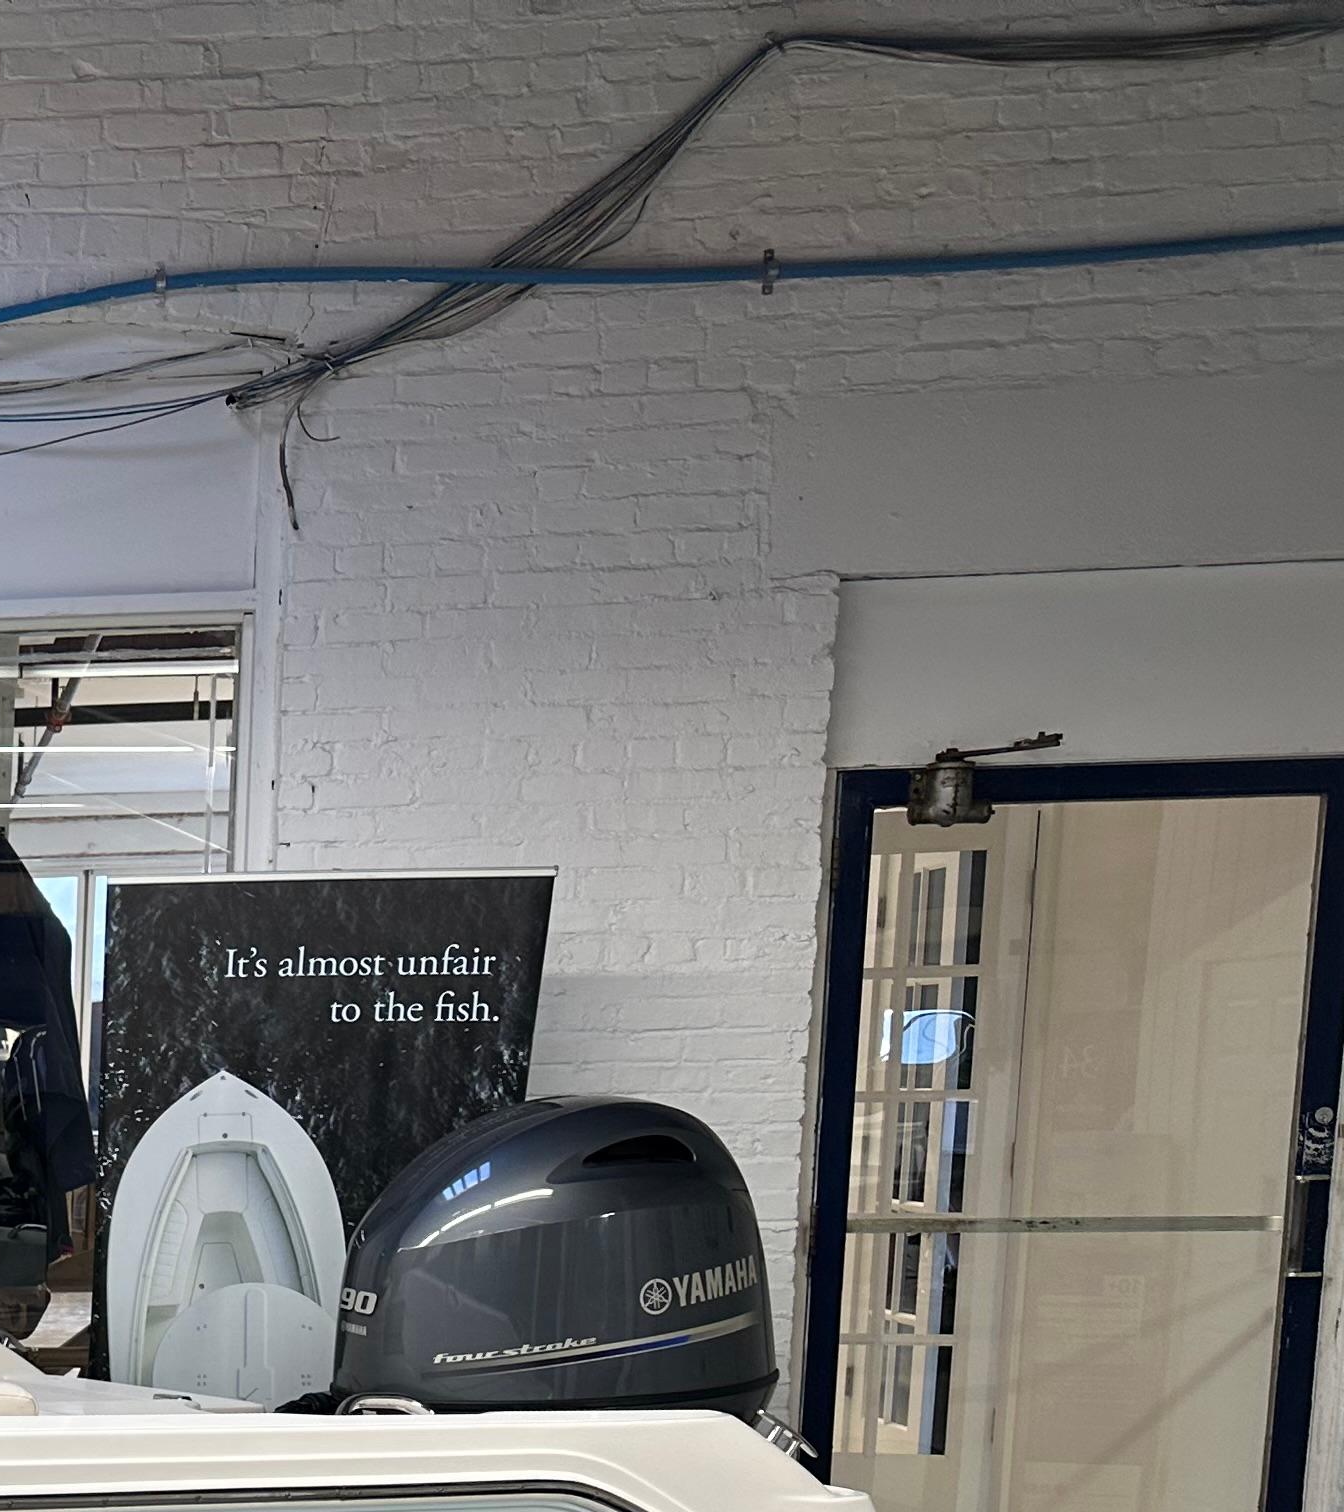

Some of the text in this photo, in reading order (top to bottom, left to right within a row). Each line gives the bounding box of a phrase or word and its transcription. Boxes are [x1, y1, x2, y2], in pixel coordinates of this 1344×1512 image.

[223, 943, 497, 978] It's almost unfair
[330, 990, 501, 1023] to the fish.
[671, 1254, 758, 1308] YAMAHA
[340, 1287, 378, 1315] 90
